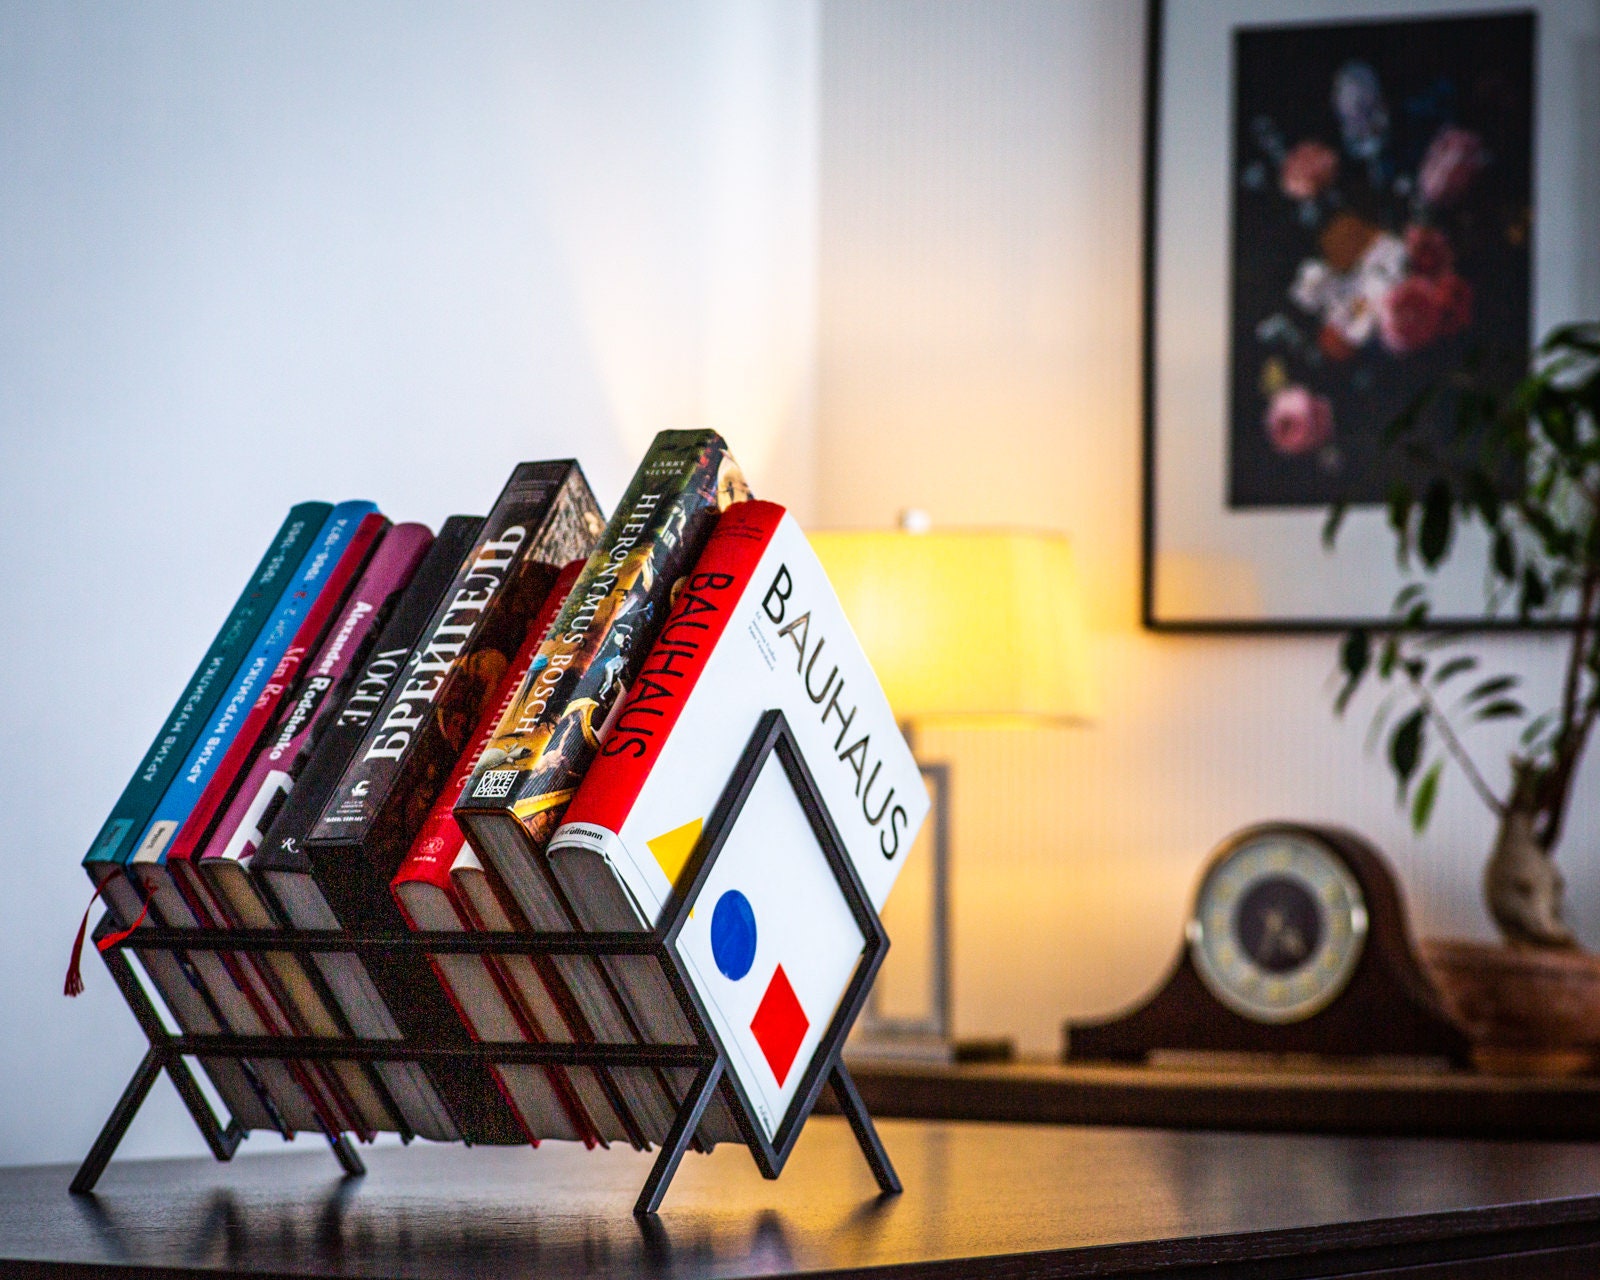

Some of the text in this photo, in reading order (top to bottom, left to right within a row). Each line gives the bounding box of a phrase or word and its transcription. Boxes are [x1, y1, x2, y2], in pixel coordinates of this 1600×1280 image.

[563, 494, 661, 644] HIERONYMUS
[269, 600, 373, 760] Alexander Rodchenko
[336, 647, 408, 727] VOGUE
[362, 525, 527, 763] БРЕЙГЕЛЬ
[514, 654, 574, 733] BOSCH
[601, 572, 735, 758] BAUHAUS
[143, 736, 176, 782] АРХИВ
[171, 657, 224, 733] МУРЗИЛКИ
[186, 737, 221, 783] АРХИВ
[214, 657, 267, 734] МУРЗИЛКИ
[762, 563, 907, 860] BAUHAUS
[476, 787, 508, 796] PRESS
[484, 771, 518, 780] ABBE
